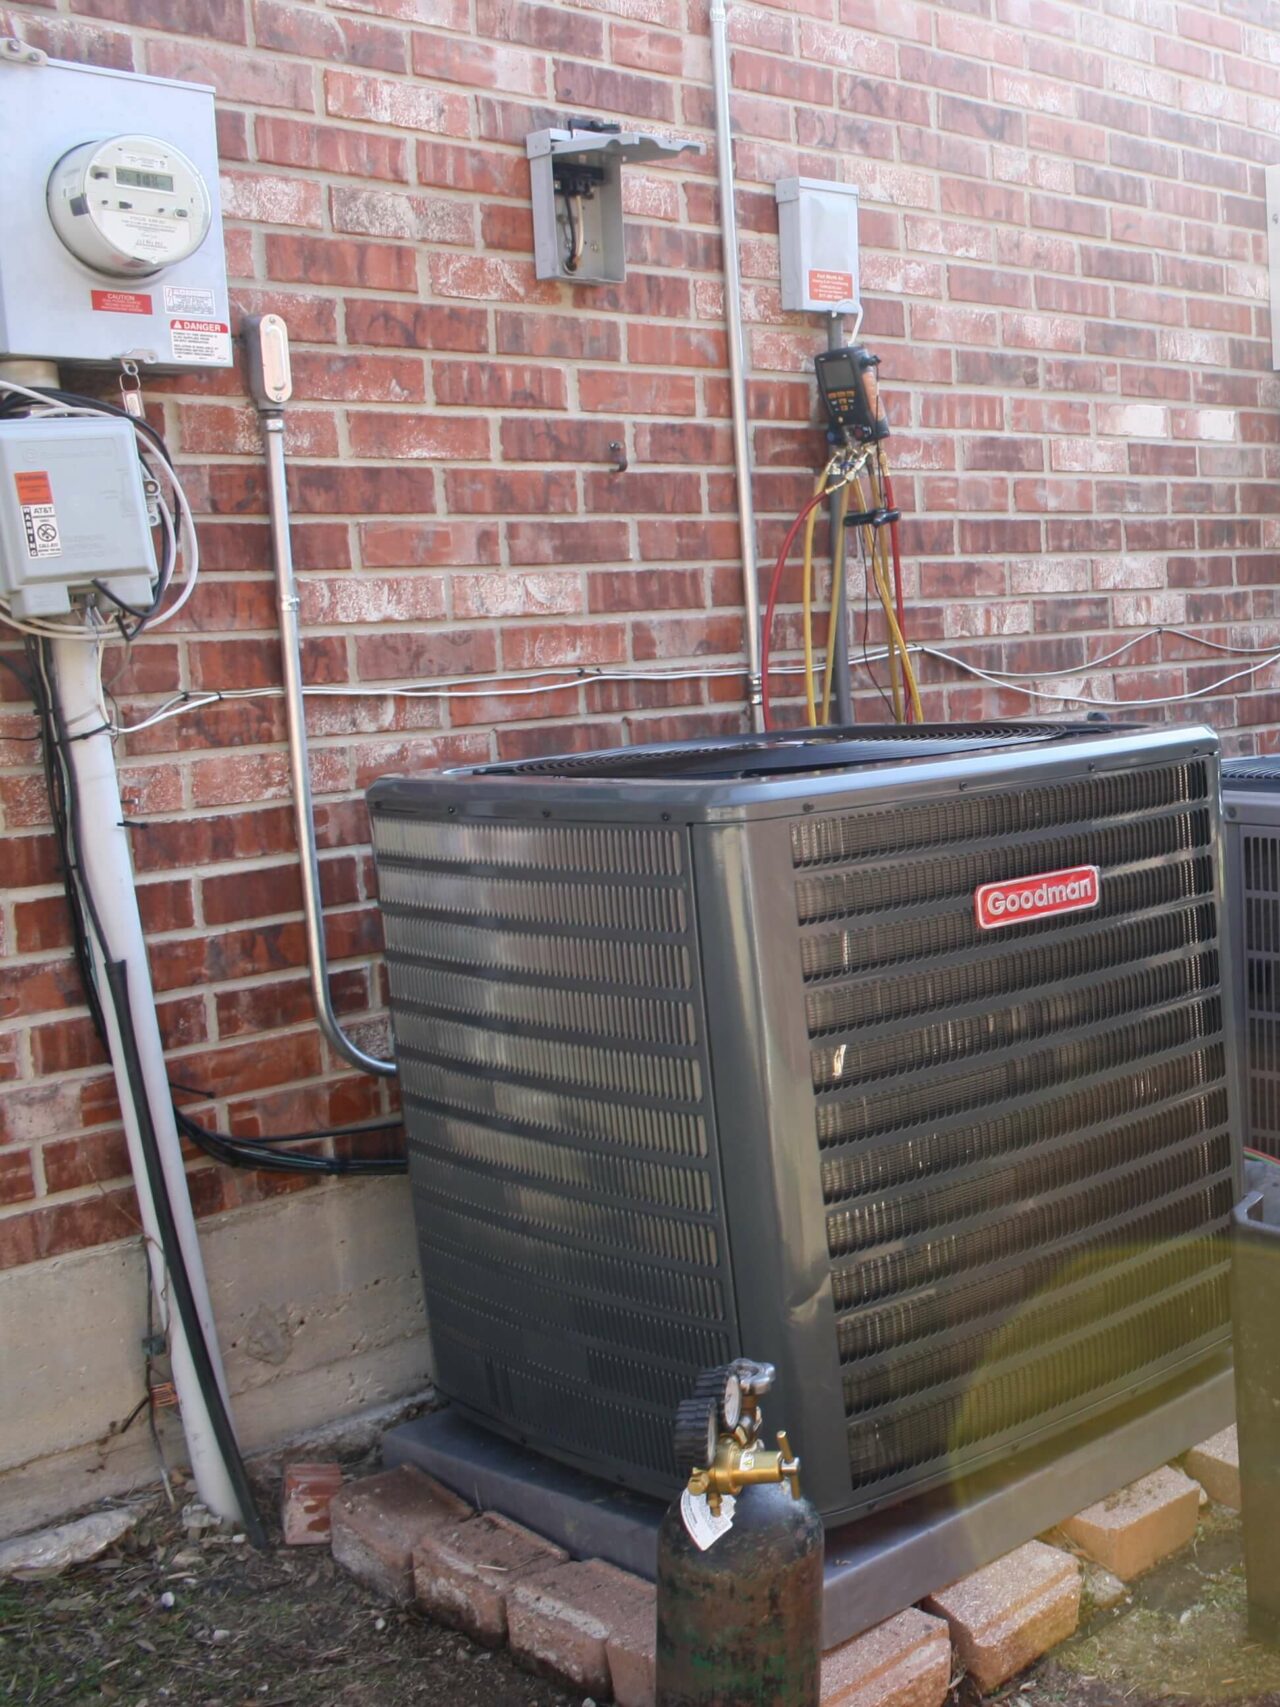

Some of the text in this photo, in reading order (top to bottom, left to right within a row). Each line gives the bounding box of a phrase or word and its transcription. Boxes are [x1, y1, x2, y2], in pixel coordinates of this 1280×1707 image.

[107, 293, 136, 301] CAUTION
[183, 321, 221, 332] DANGER
[23, 507, 39, 557] WARNING
[987, 879, 1092, 915] Goodman
